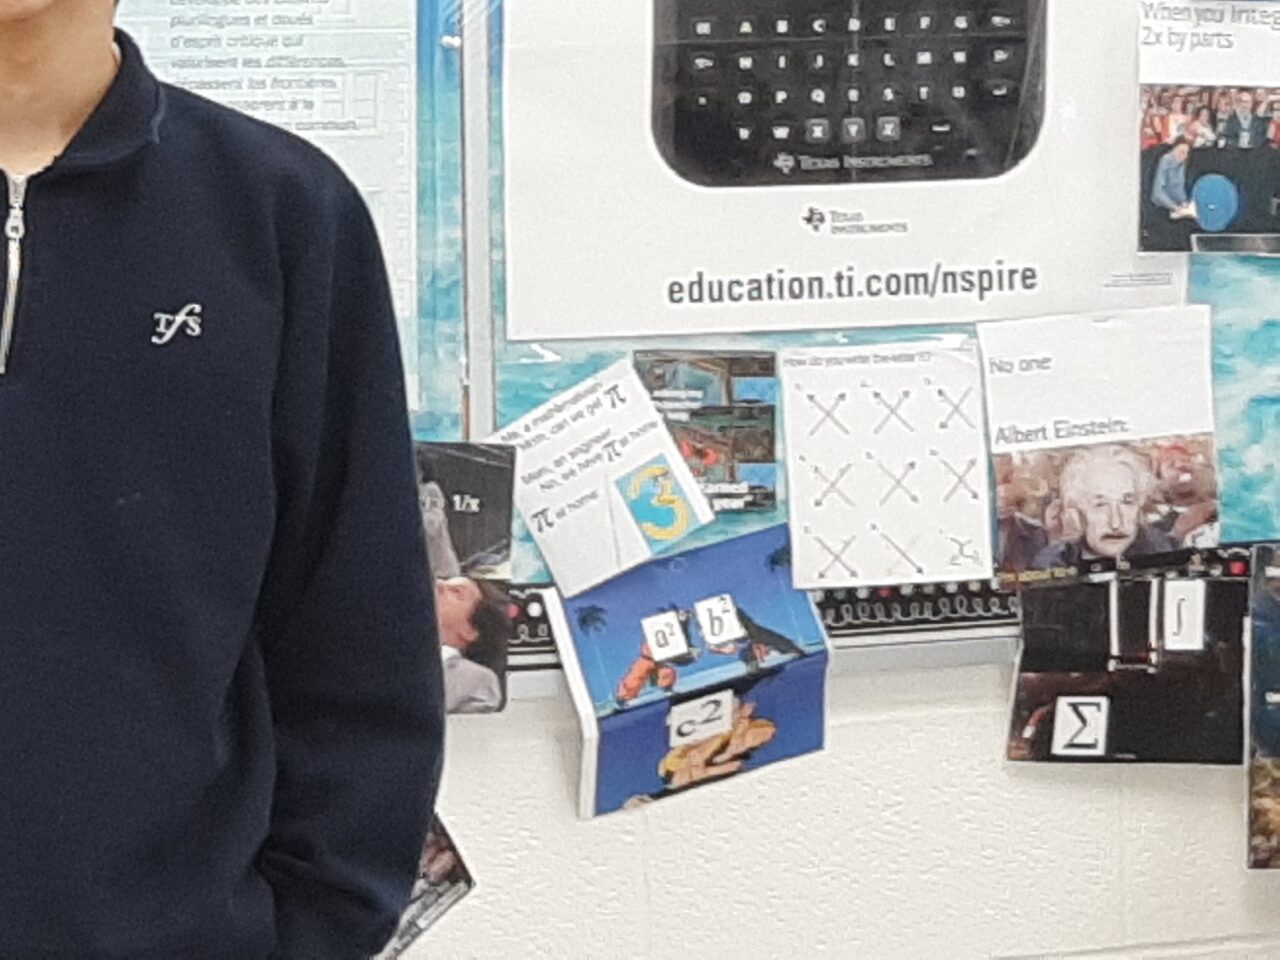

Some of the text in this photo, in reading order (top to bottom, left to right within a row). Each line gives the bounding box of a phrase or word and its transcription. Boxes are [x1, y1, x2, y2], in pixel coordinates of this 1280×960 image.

[667, 260, 1038, 306] education.ti.com/nspire
[989, 356, 1014, 374] No
[995, 424, 1048, 445] Albert
